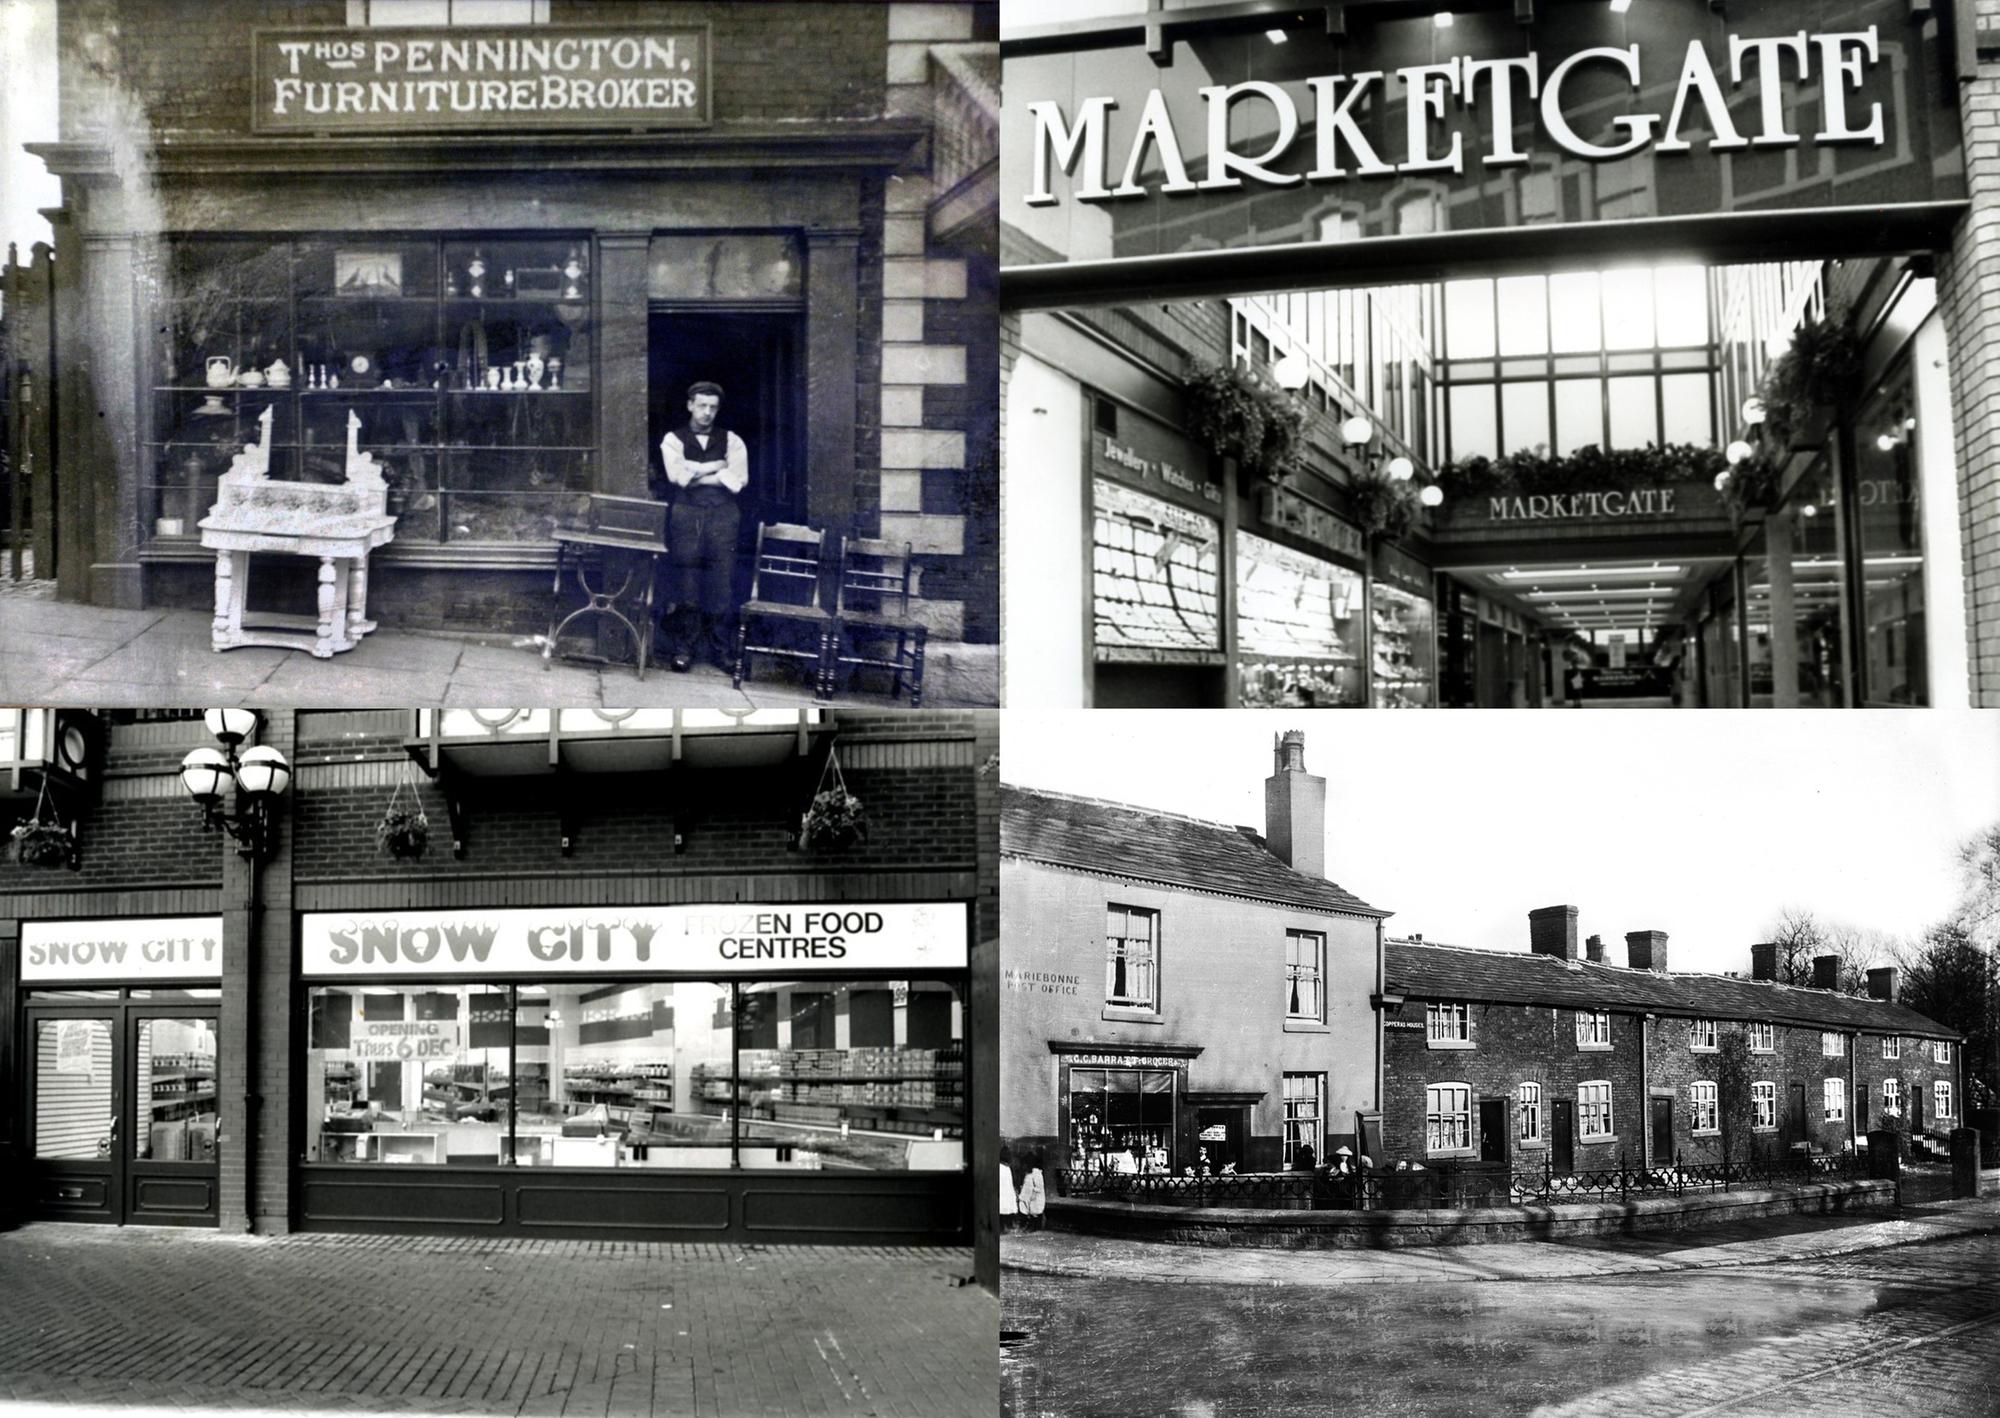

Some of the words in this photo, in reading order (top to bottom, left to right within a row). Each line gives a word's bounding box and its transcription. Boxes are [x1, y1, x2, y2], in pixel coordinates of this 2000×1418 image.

[1024, 25, 1884, 206] MARKETGATE
[1489, 488, 1675, 520] MARKETGATE
[804, 911, 884, 935] FOOD
[28, 940, 128, 966] SNOW
[142, 937, 217, 963] CITY
[328, 919, 501, 965] SNOW
[527, 914, 663, 963] CITY
[718, 936, 847, 960] CENTRES
[1041, 983, 1078, 996] OFFICE
[368, 1023, 440, 1036] OPENING
[397, 1034, 413, 1059] 6
